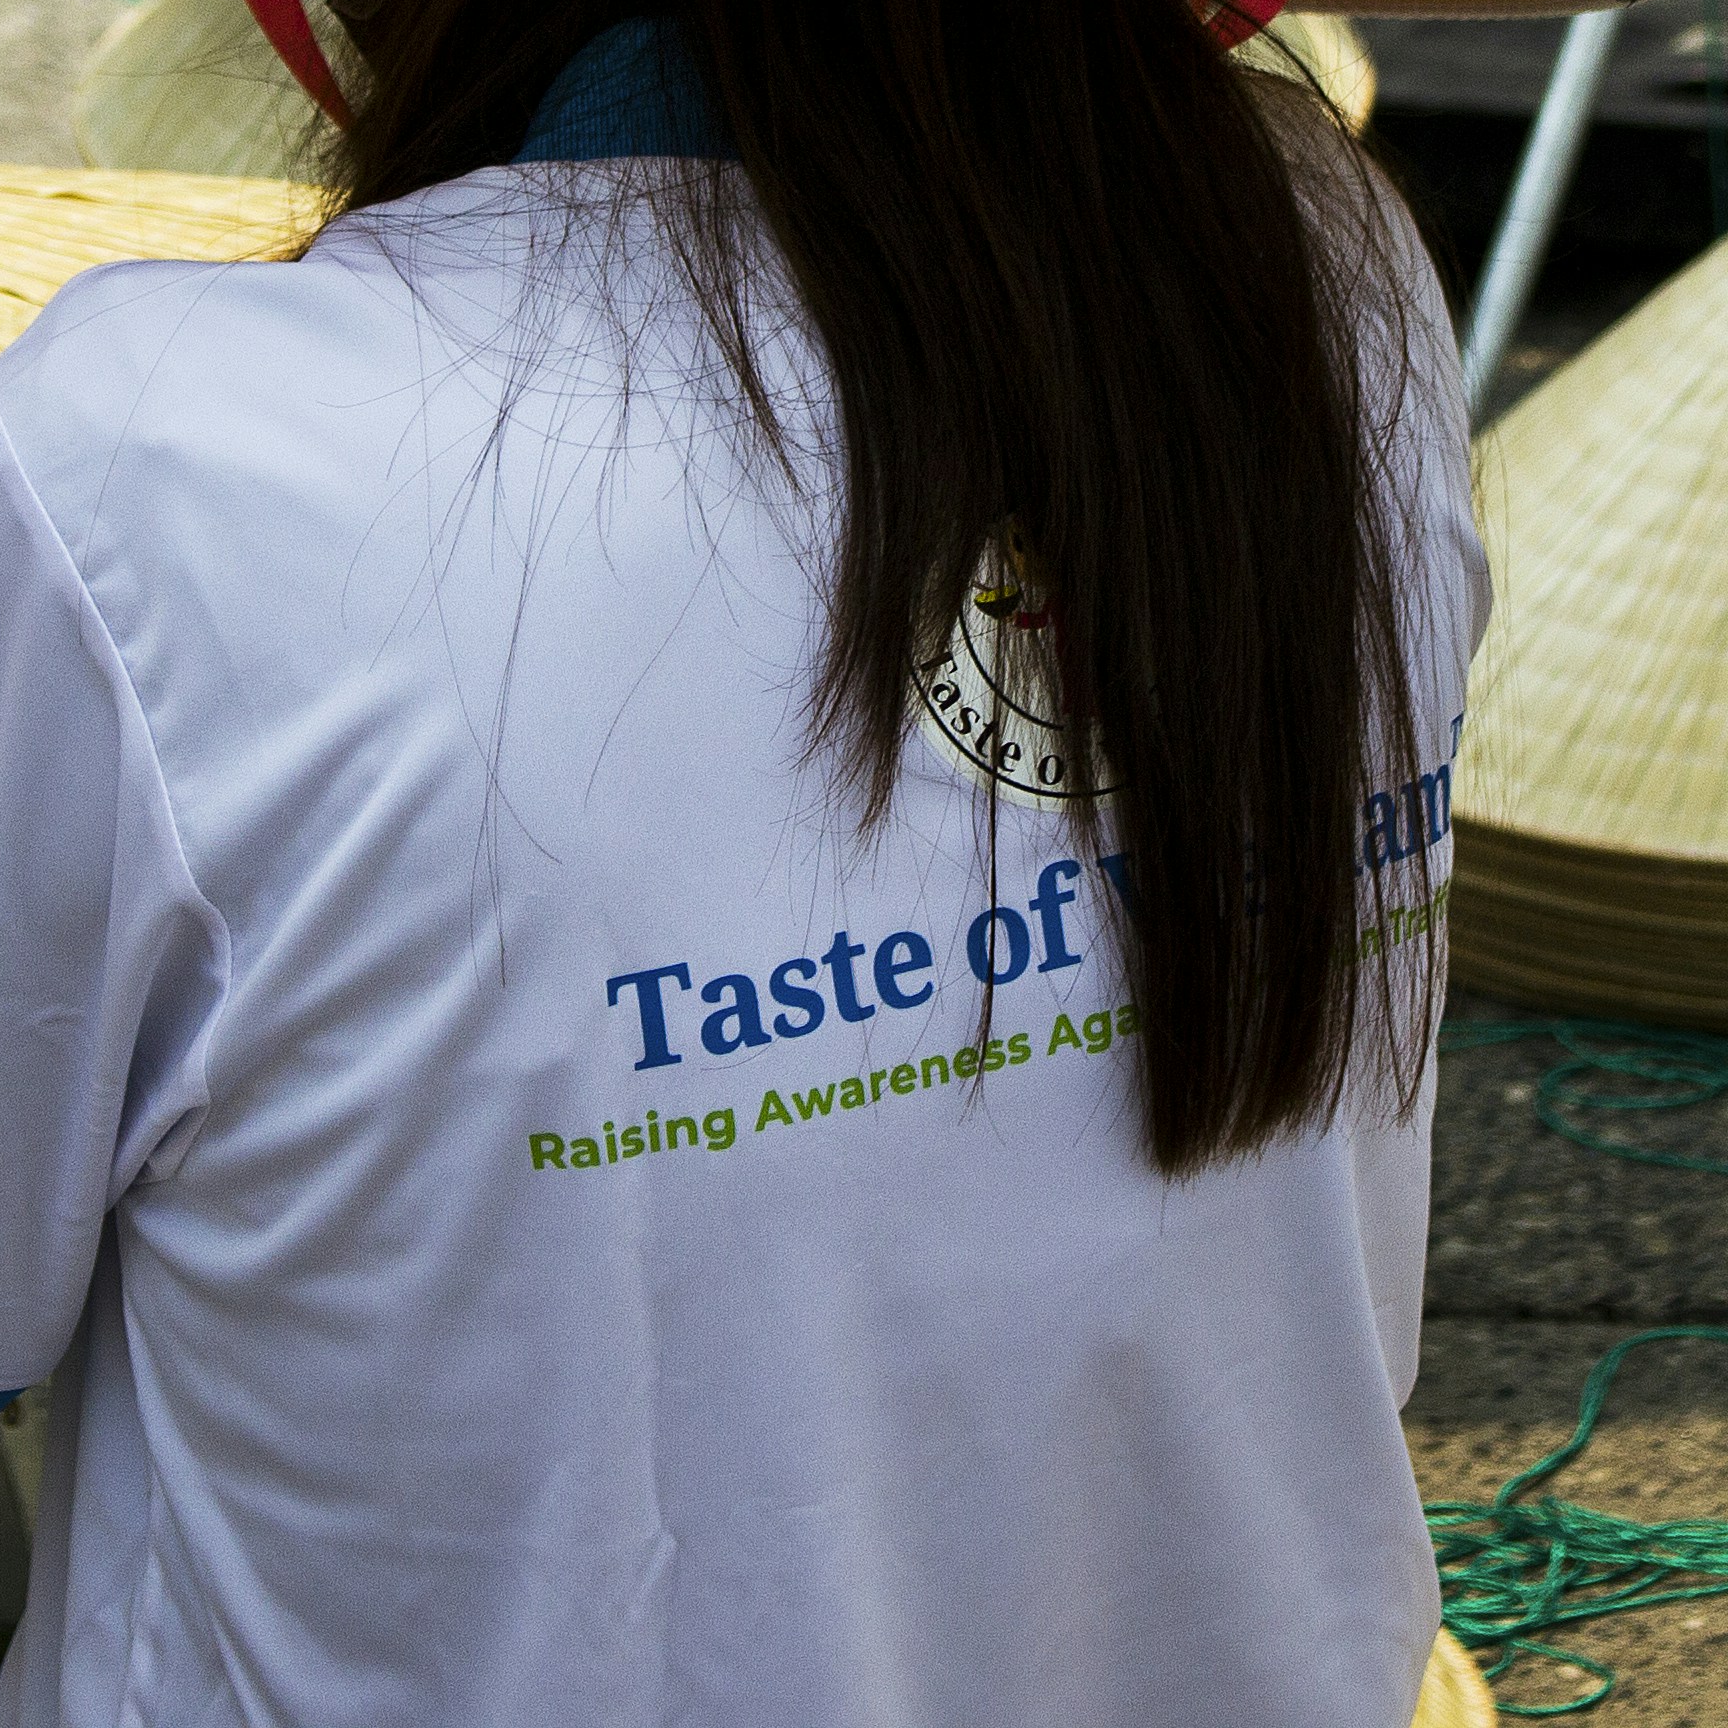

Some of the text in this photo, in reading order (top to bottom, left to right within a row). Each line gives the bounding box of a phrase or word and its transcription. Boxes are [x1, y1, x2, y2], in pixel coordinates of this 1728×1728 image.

[918, 651, 1022, 773] Taste
[605, 858, 1083, 1071] Taste of
[528, 1108, 737, 1171] Raising
[754, 1032, 1033, 1133] Awareness
